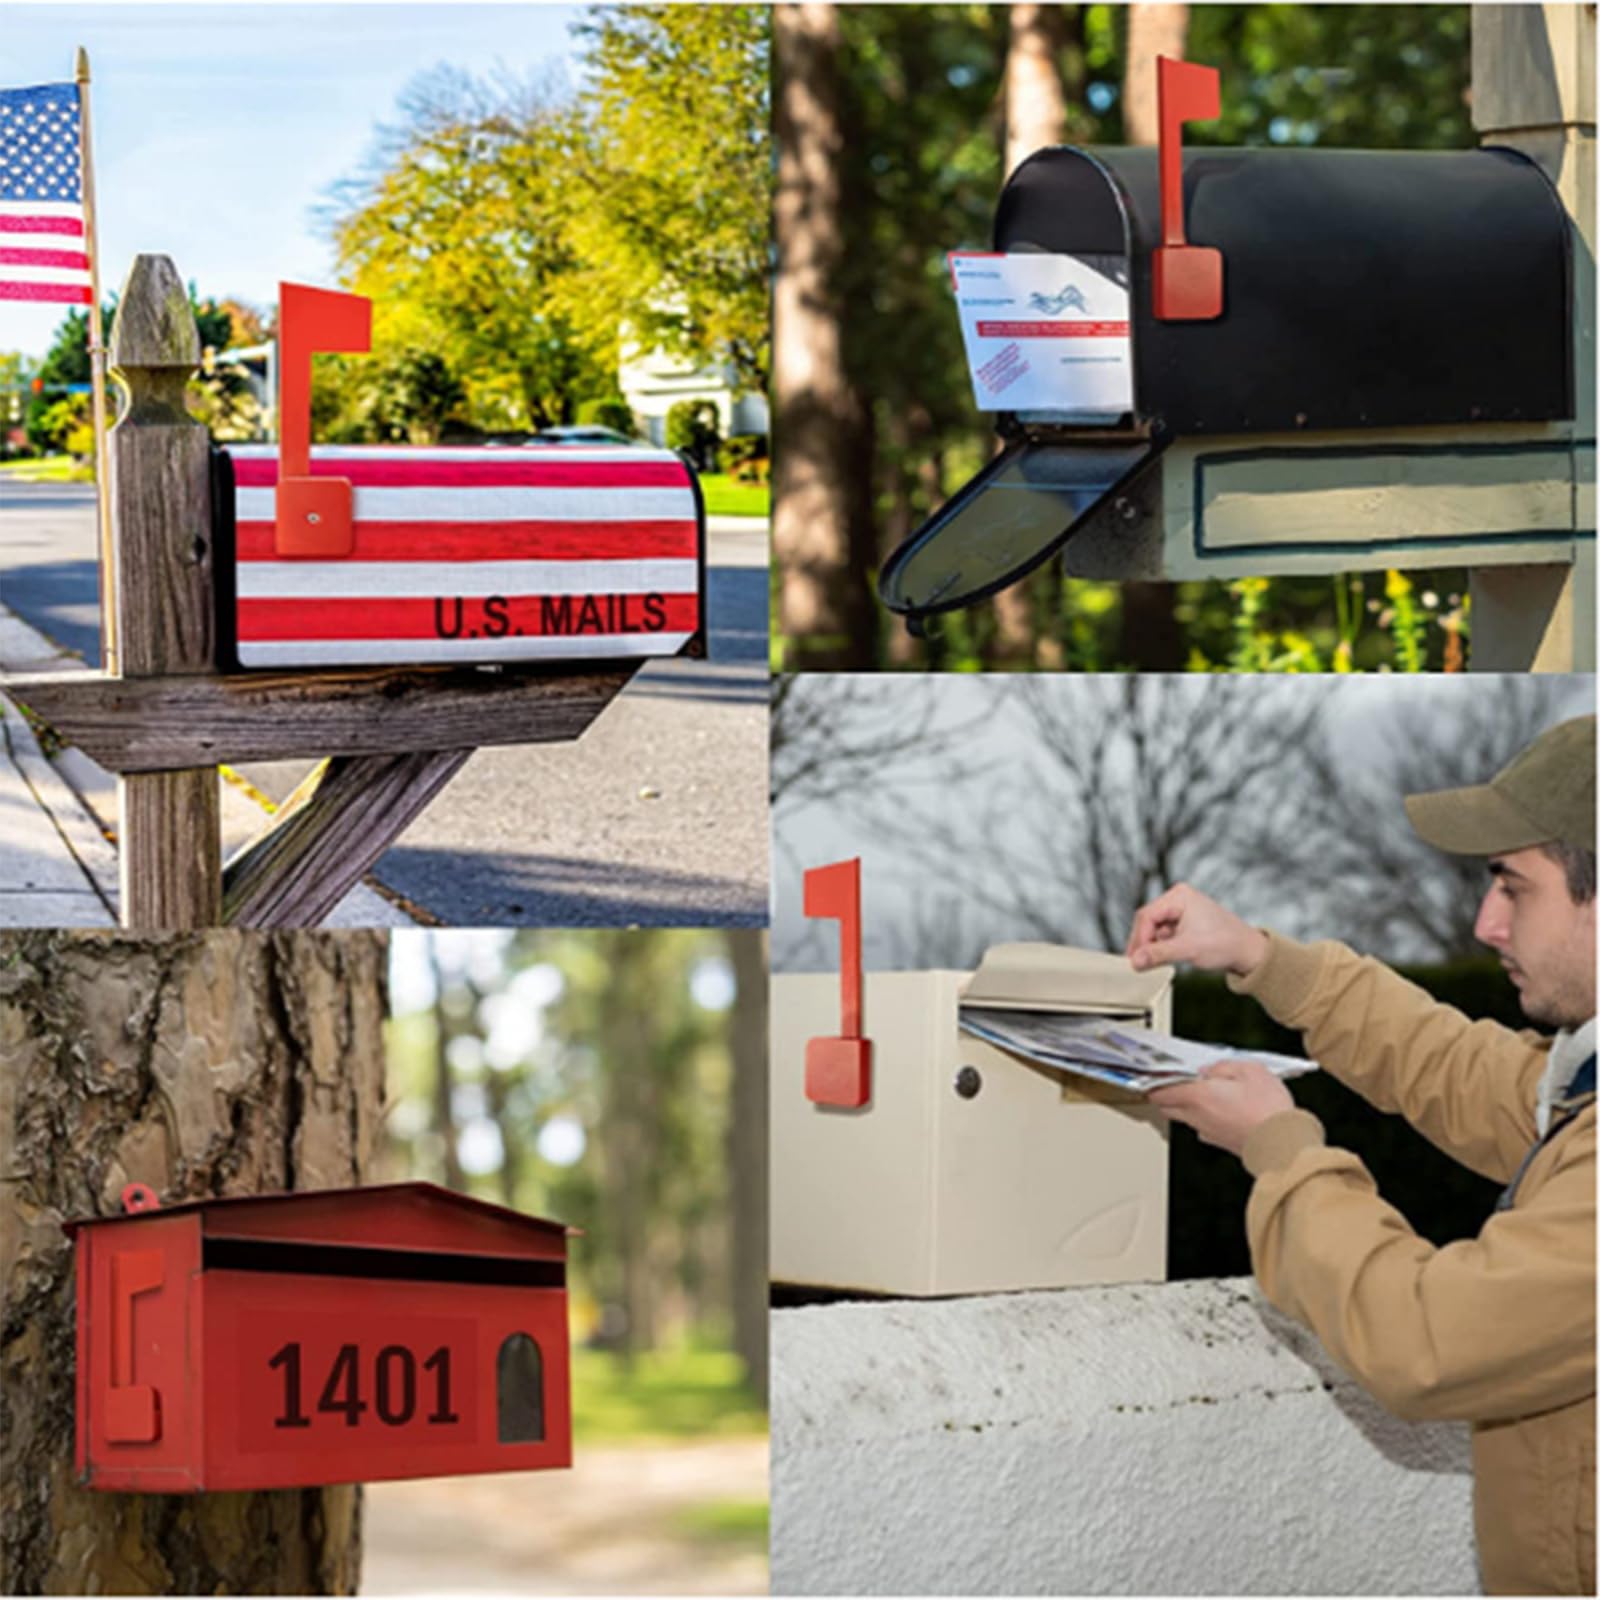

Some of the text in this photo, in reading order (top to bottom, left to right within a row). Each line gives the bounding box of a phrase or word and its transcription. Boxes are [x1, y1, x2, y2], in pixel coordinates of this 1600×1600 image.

[435, 594, 667, 638] U.S. MAILS
[268, 1342, 459, 1428] 1401
